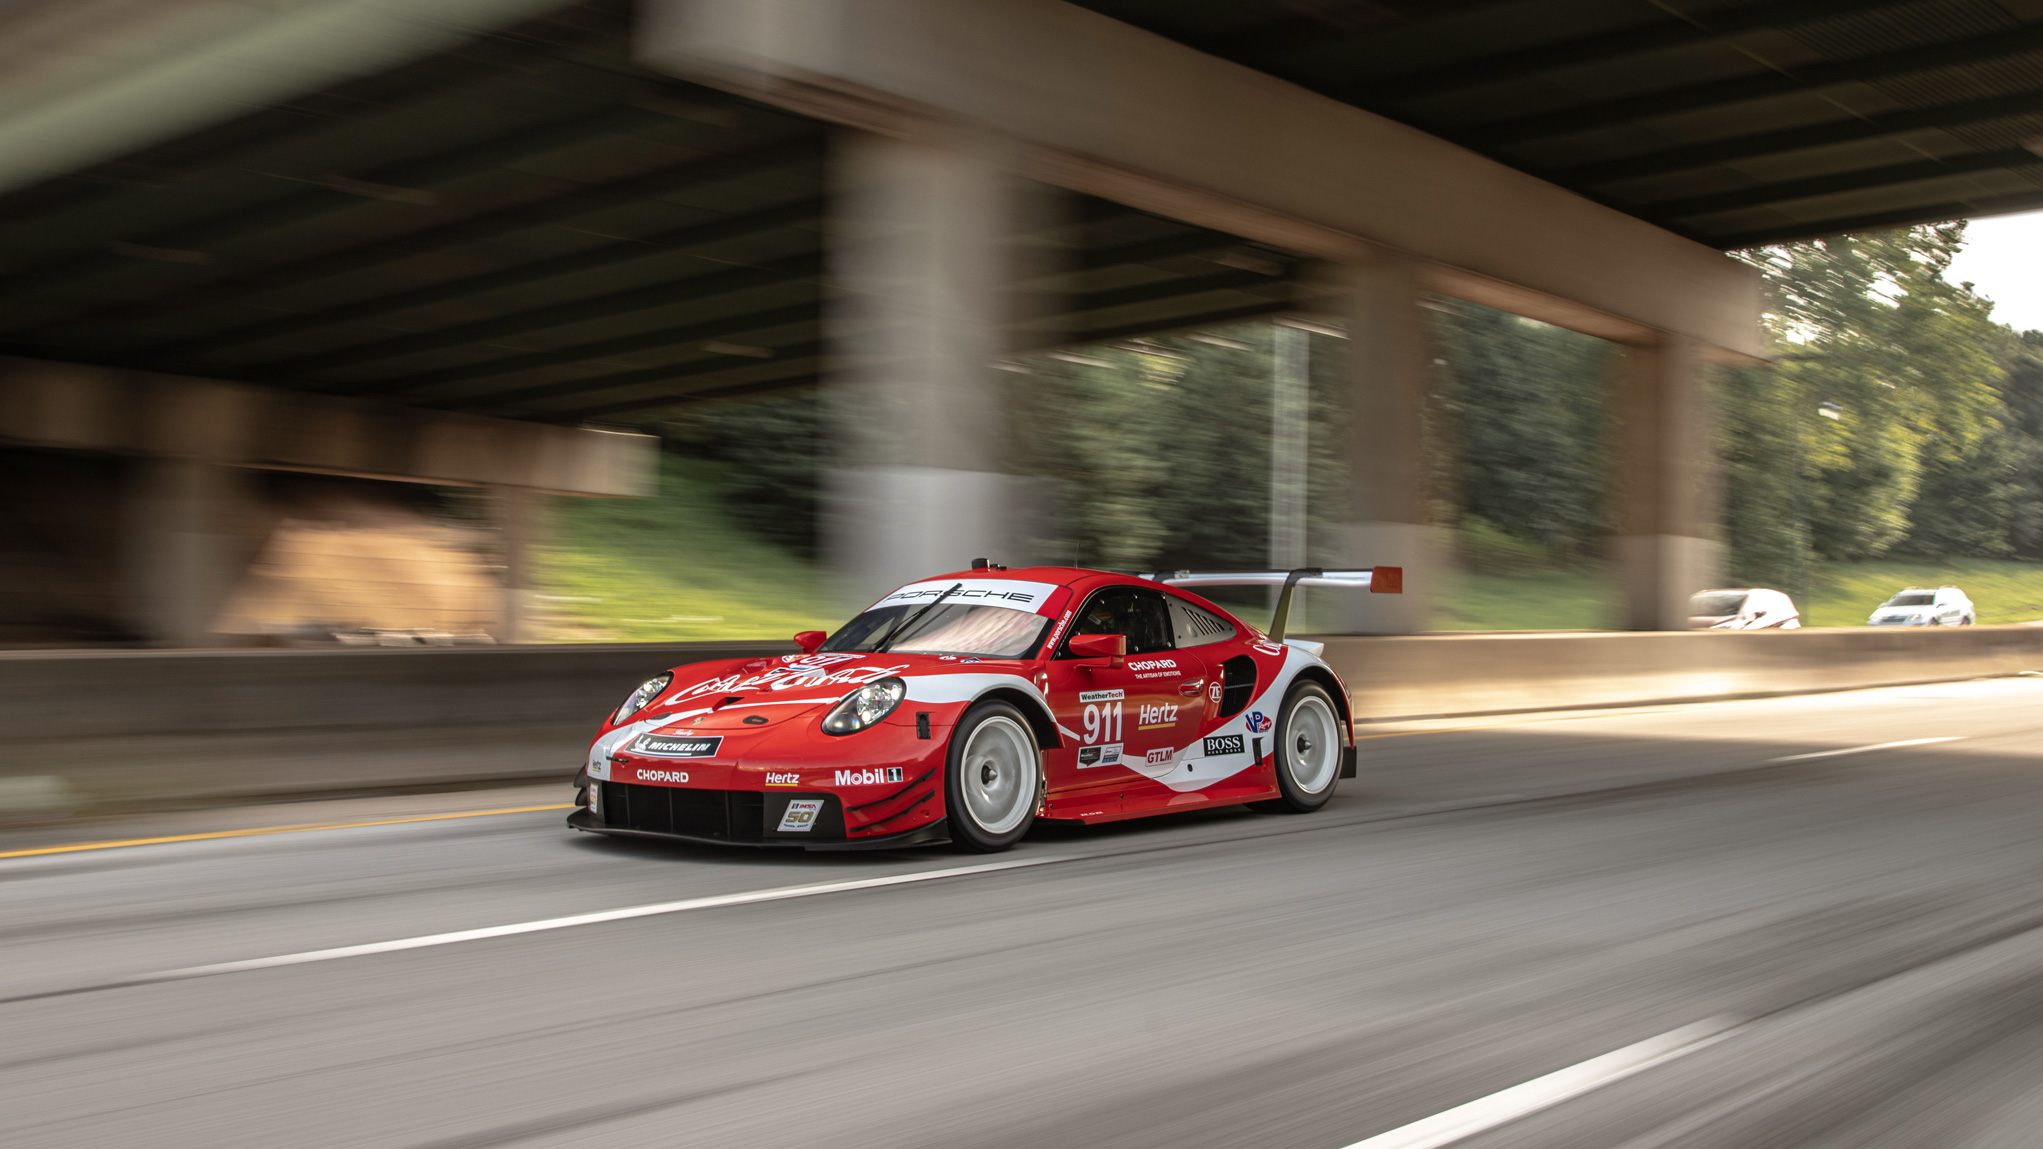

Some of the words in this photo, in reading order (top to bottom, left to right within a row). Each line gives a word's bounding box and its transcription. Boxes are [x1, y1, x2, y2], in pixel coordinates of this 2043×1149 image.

[883, 590, 1035, 603] PORSCHE
[1127, 659, 1178, 671] CHOPARD
[1081, 691, 1123, 701] WeatherTech
[1209, 686, 1221, 699] ZF
[1138, 702, 1179, 725] Hertz
[1083, 701, 1123, 745] 911
[1245, 711, 1264, 734] VP
[647, 742, 712, 752] MICHELIN
[1206, 736, 1241, 751] BOSS
[1147, 749, 1173, 764] GTLM
[636, 768, 690, 783] CHOPARD
[765, 772, 801, 784] Hertz
[834, 768, 885, 786] Mobil
[889, 768, 900, 782] 1
[785, 811, 815, 823] 50
